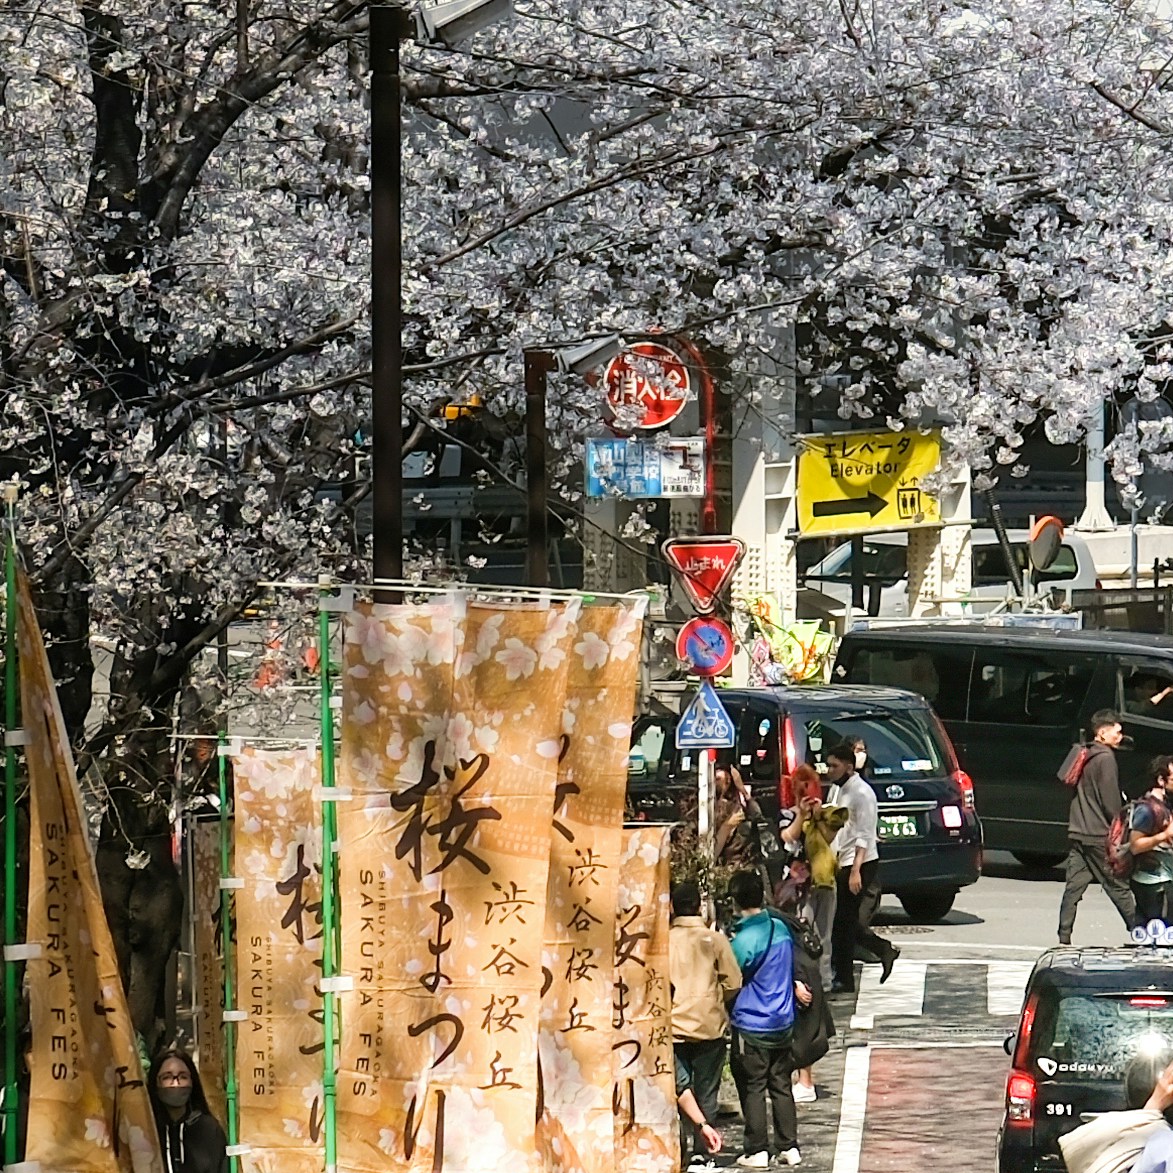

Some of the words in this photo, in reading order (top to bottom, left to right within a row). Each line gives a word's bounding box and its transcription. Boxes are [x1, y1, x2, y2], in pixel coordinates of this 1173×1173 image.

[823, 436, 912, 459] エレベータ
[831, 461, 901, 478] Elevator
[685, 555, 726, 576] 止まれ
[45, 822, 61, 978] SAKURA
[357, 868, 374, 1007] SAKURA
[559, 848, 608, 1033] 渋谷桜丘
[250, 935, 264, 1033] SAKURA
[478, 880, 536, 1091] 渋谷桜丘
[644, 968, 672, 1078] 渋谷桜丘
[51, 1008, 67, 1081] FES
[253, 1051, 265, 1097] FES
[352, 1032, 372, 1097] FES
